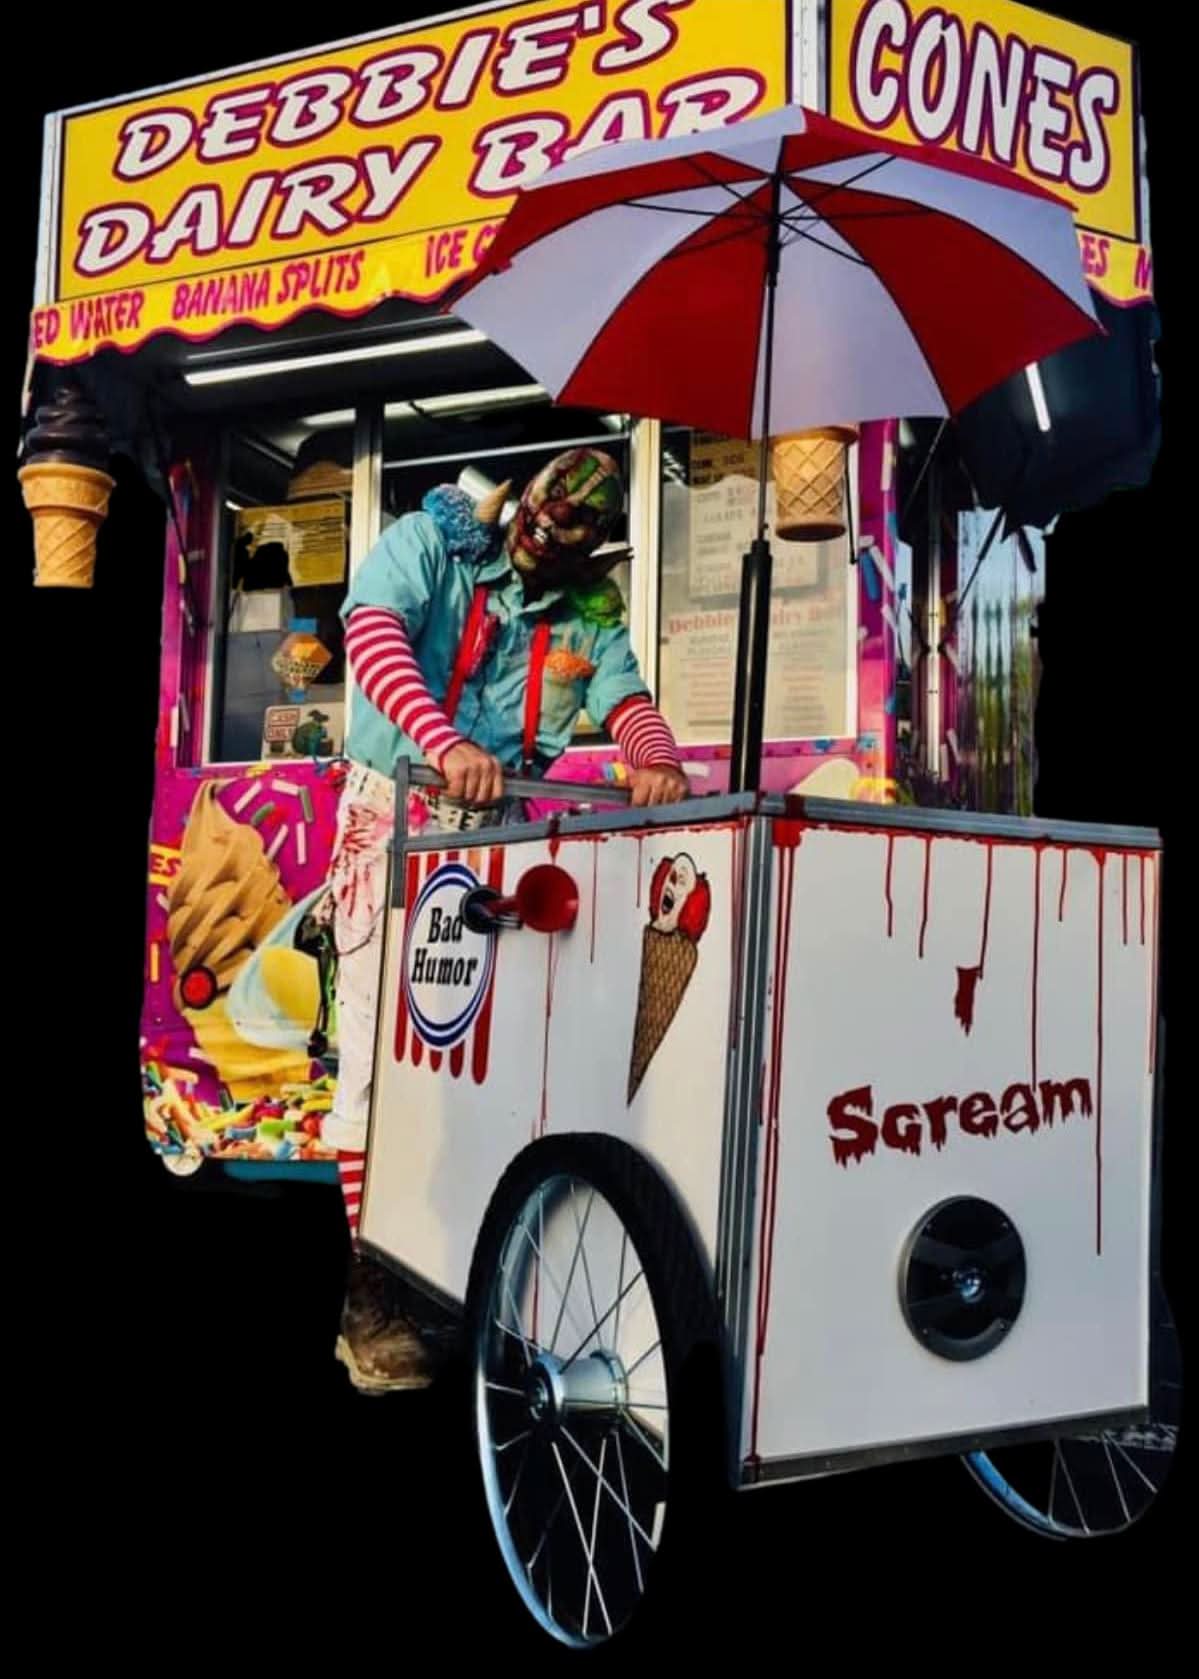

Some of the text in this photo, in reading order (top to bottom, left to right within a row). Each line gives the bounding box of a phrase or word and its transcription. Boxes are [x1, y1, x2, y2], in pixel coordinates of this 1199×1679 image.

[114, 0, 688, 182] DEBBIE'S
[850, 0, 1120, 198] CONES
[74, 69, 766, 276] DAIRY BAR
[71, 291, 144, 341] WATER
[171, 269, 271, 321] BANANA
[276, 250, 365, 304] SPLITS
[425, 231, 469, 280] ICE
[411, 947, 479, 987] Humor
[427, 907, 463, 943] Bad
[826, 1077, 1093, 1169] Scream
